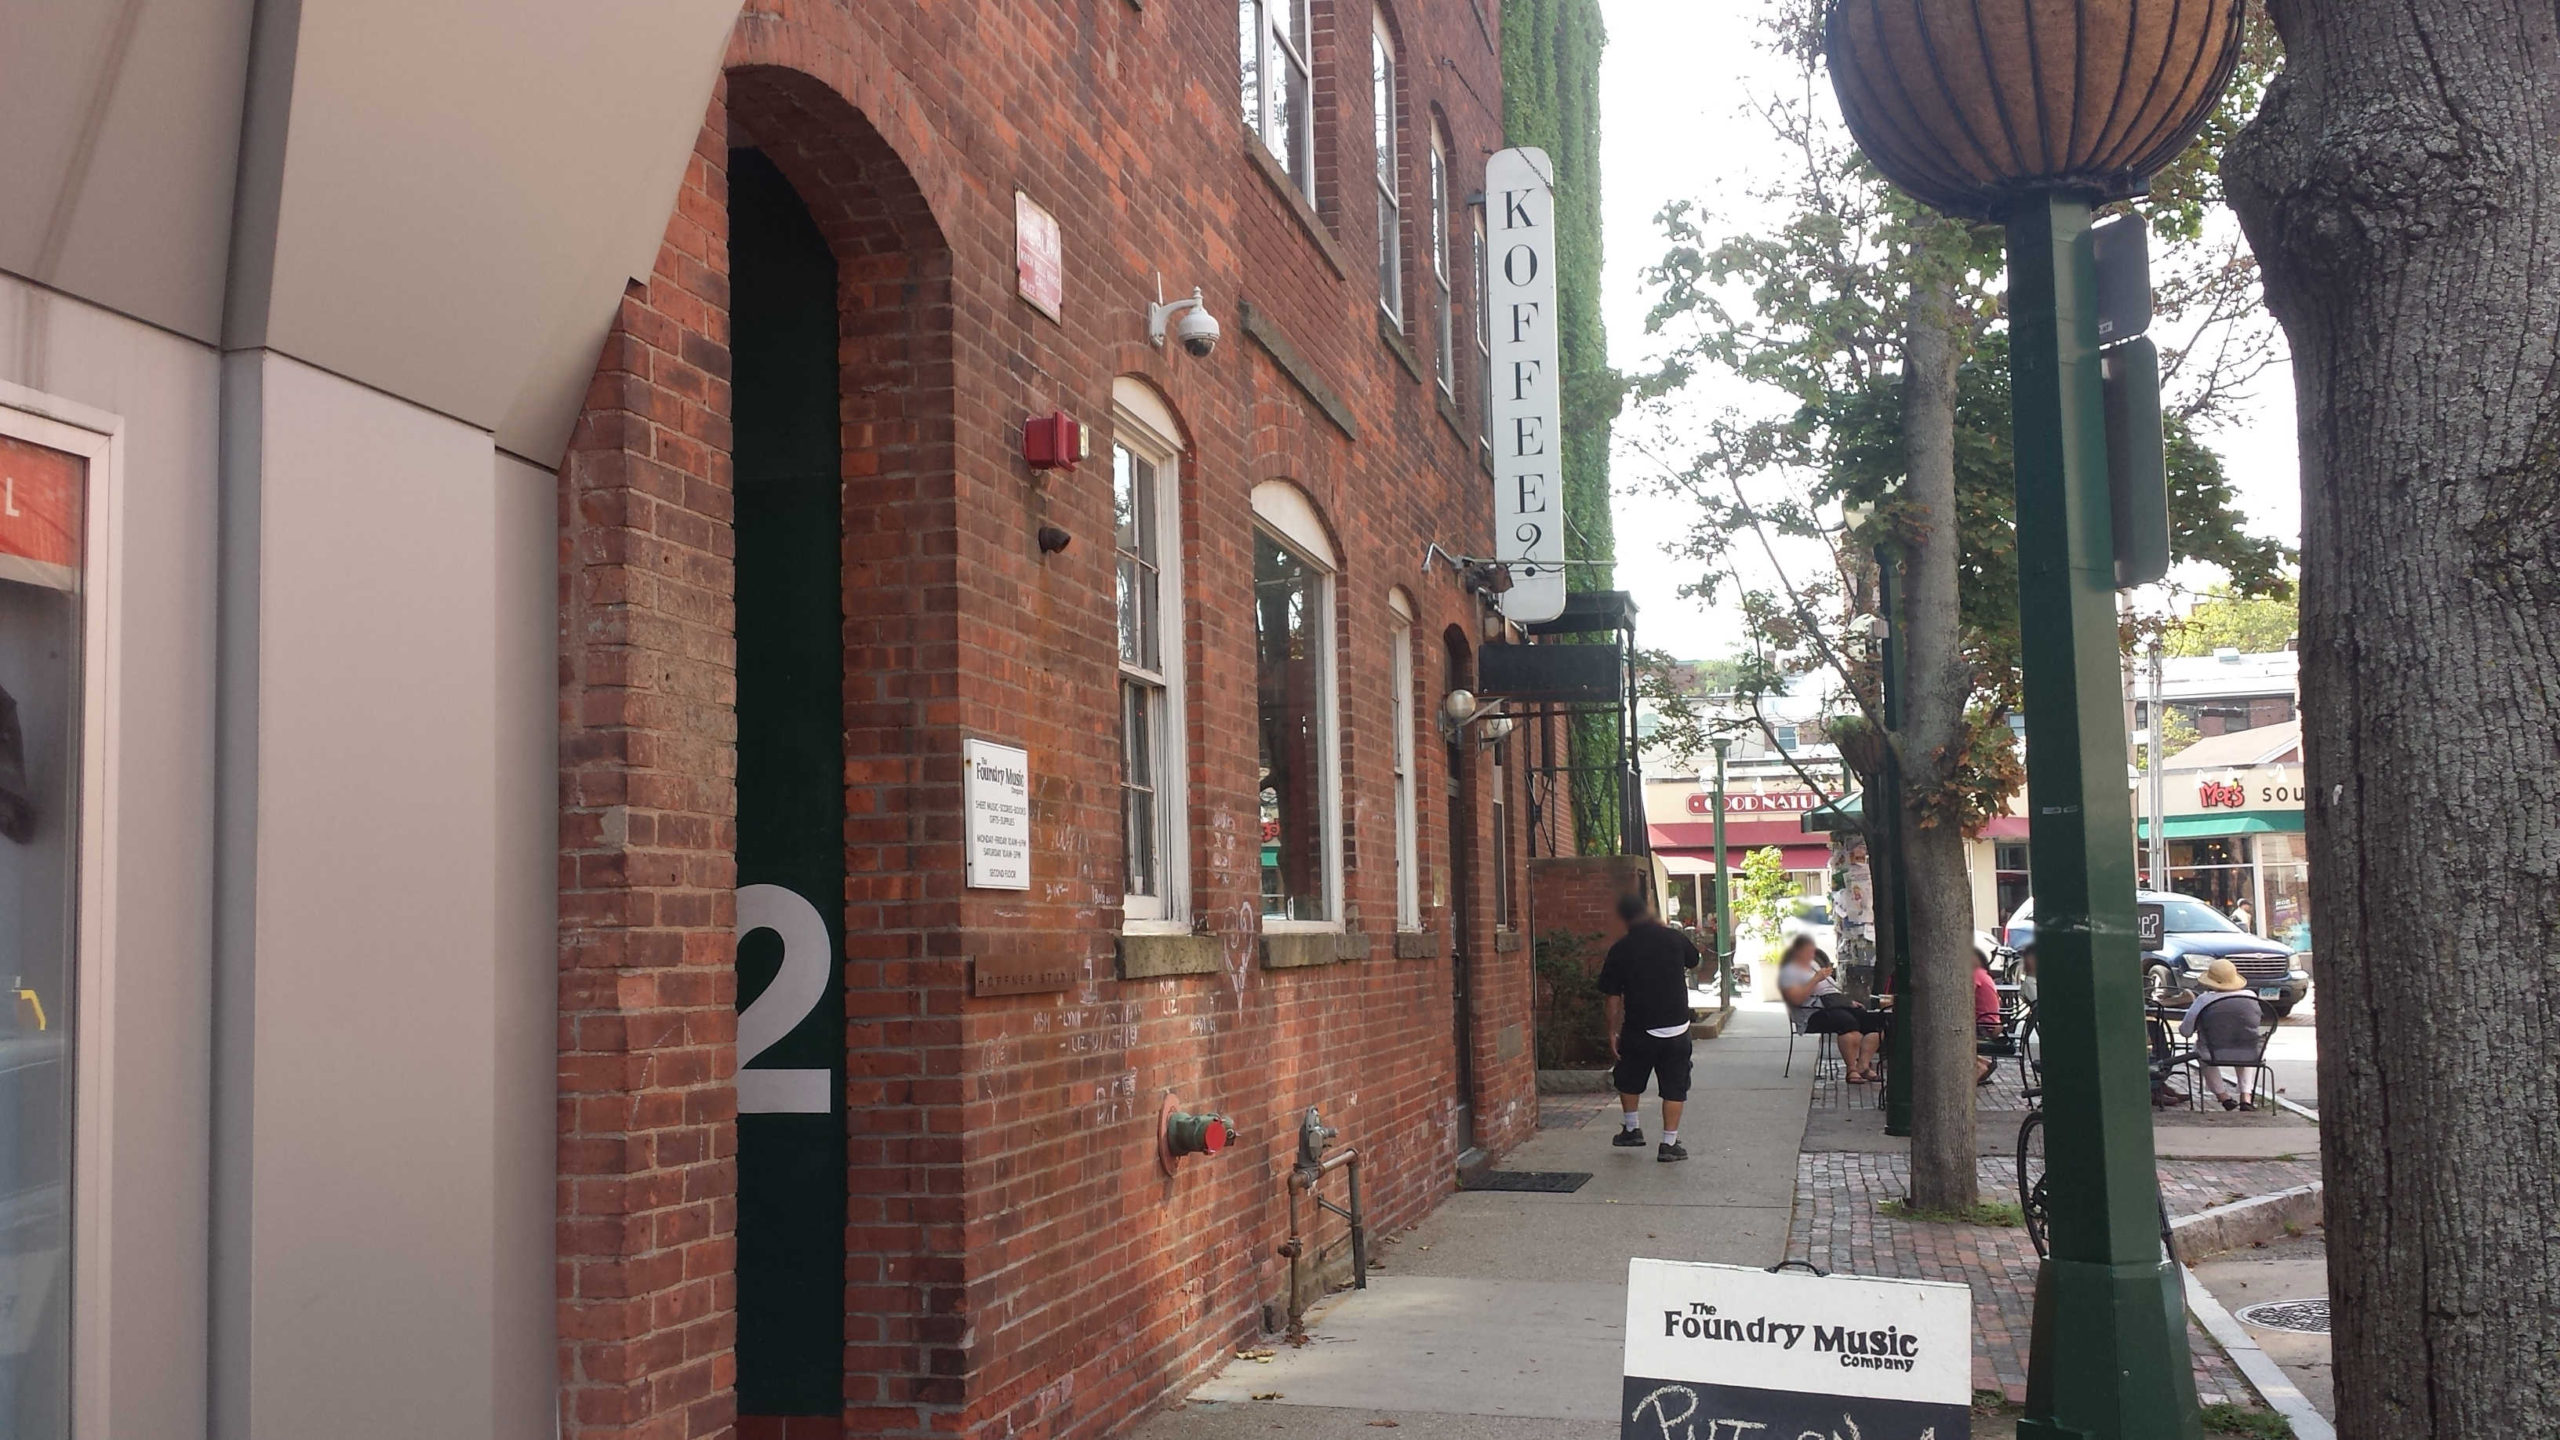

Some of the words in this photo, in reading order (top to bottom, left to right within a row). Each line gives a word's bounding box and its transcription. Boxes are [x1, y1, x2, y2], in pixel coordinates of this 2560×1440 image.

[1500, 188, 1546, 577] KOFFEE?
[976, 762, 1004, 786] Foundry
[1005, 768, 1024, 787] Music
[737, 884, 831, 1113] 2
[1690, 1302, 1716, 1315] The
[1664, 1311, 1805, 1349] Foundry
[1813, 1326, 1919, 1357] Music
[1840, 1353, 1914, 1372] Company
